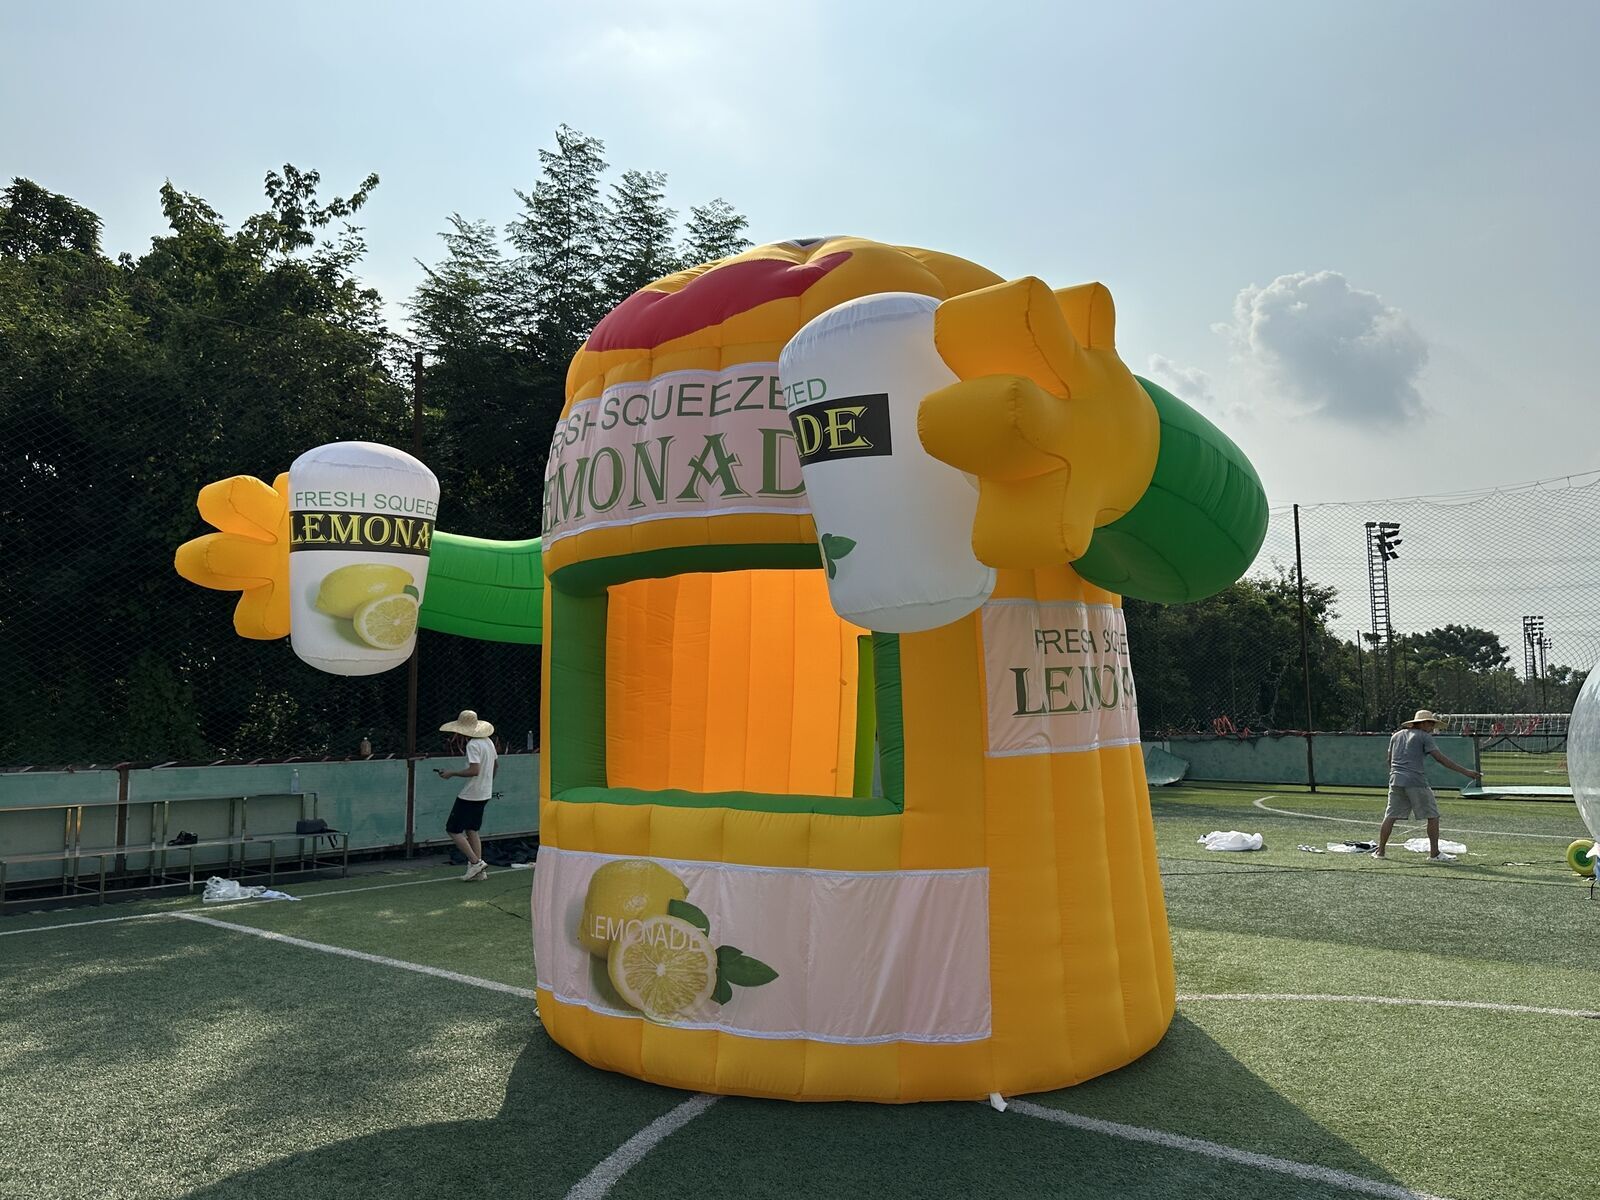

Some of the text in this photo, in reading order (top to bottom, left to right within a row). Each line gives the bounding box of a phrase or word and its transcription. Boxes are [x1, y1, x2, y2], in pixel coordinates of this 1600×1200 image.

[794, 405, 874, 458] DE
[295, 491, 366, 508] FRESH
[590, 913, 707, 952] LEMONADE
